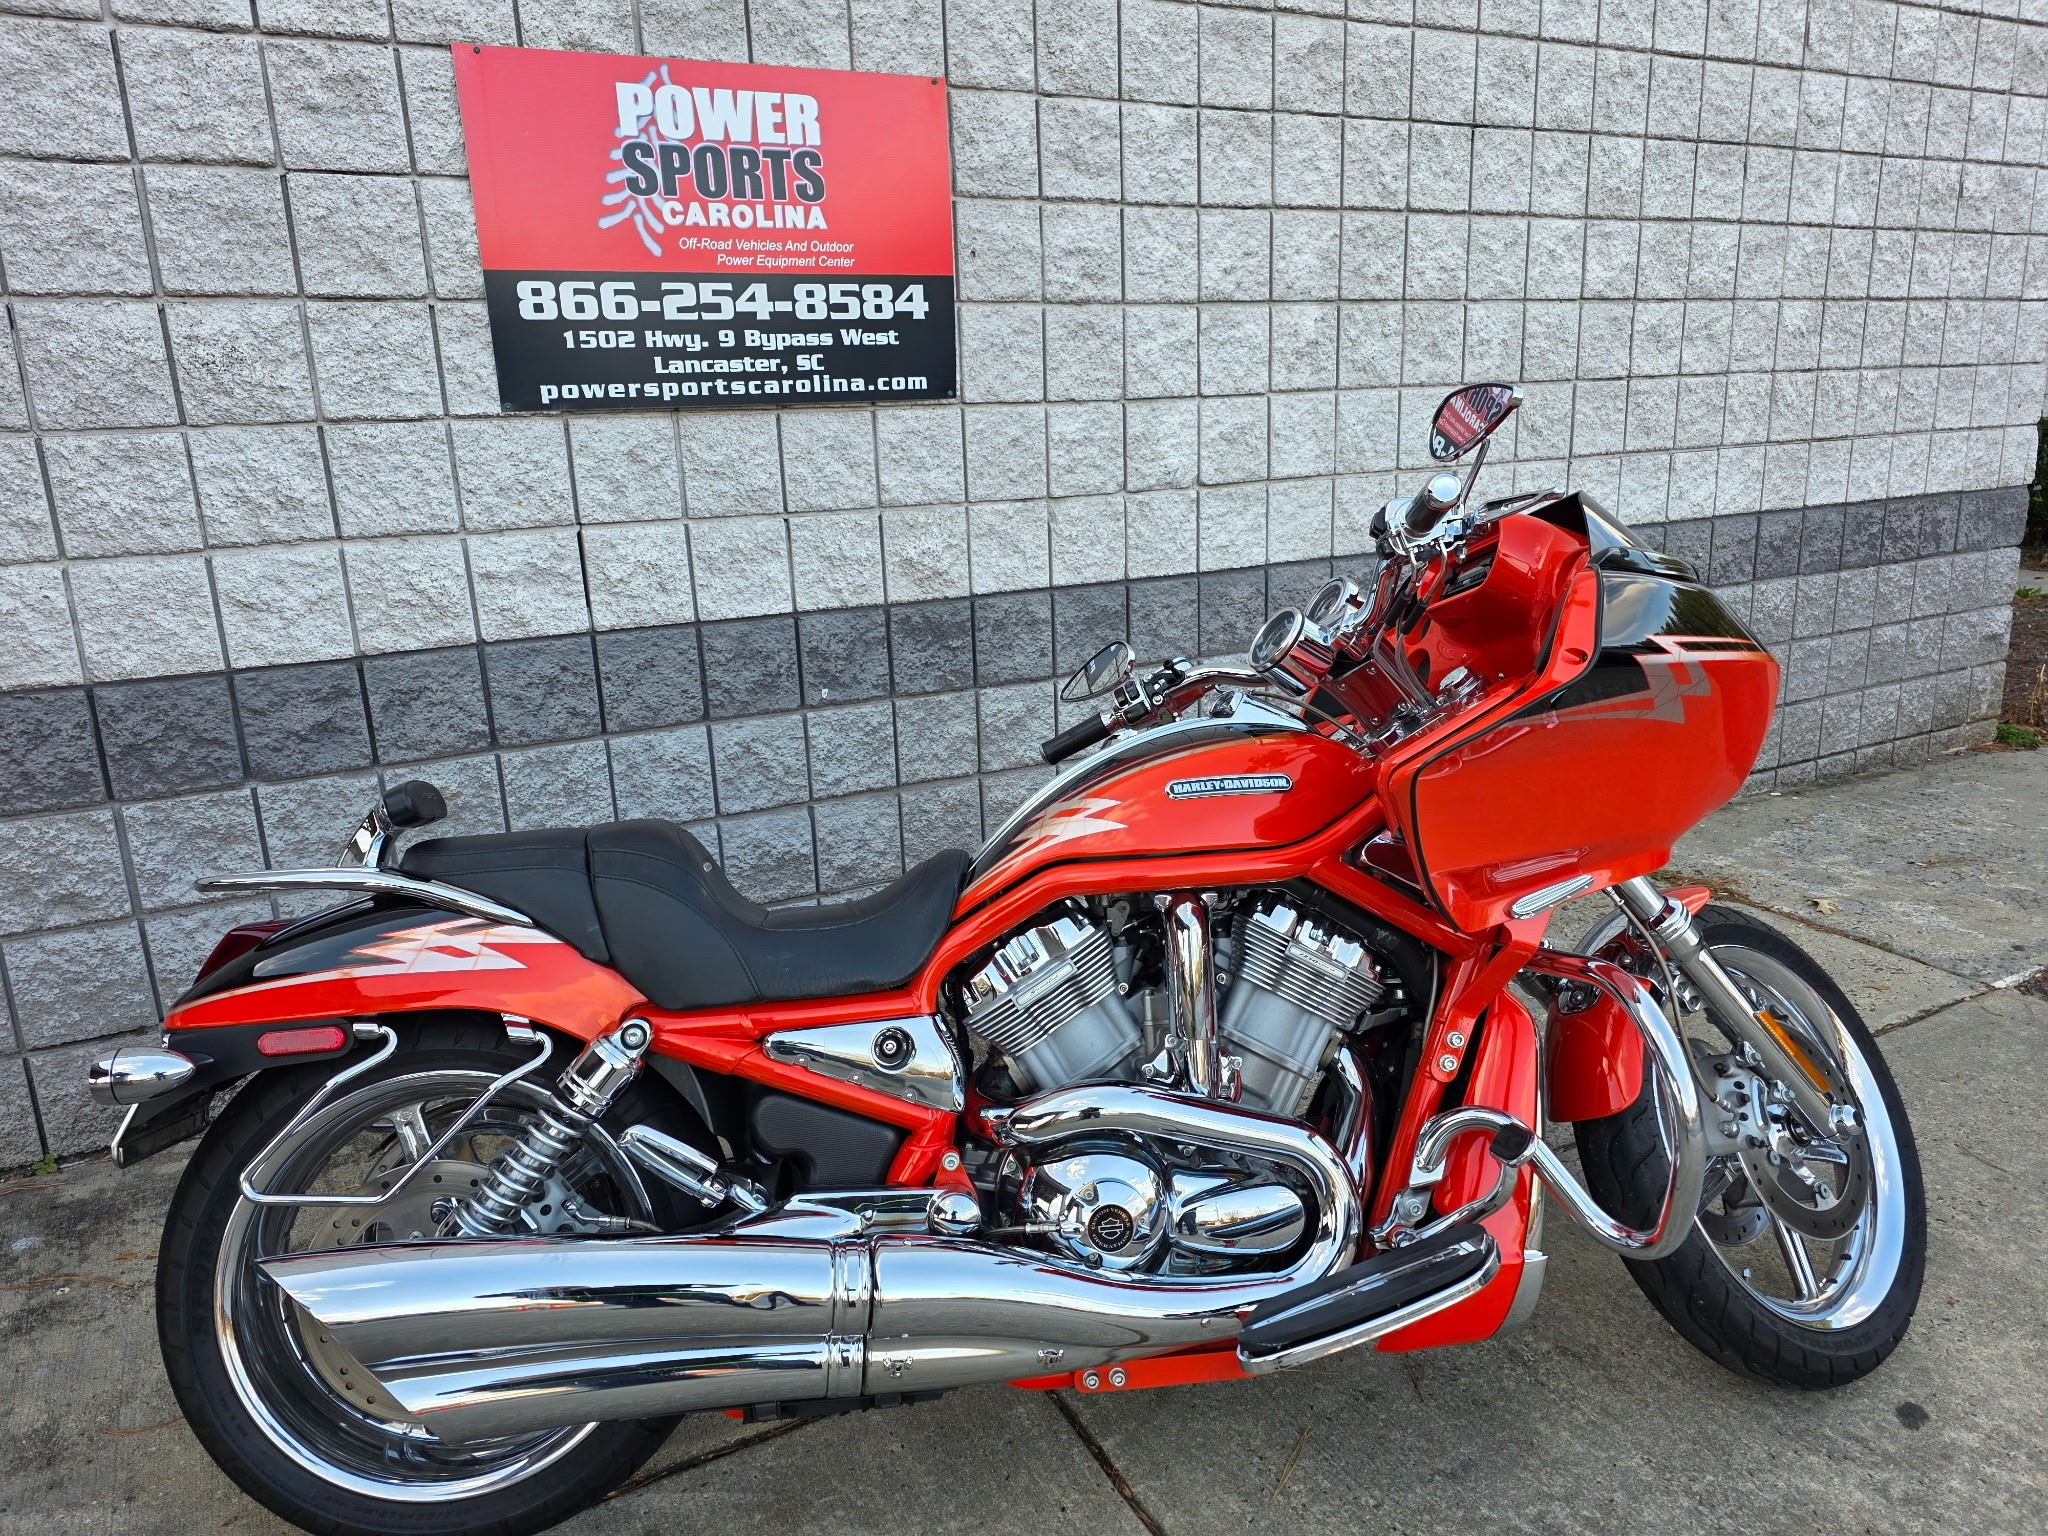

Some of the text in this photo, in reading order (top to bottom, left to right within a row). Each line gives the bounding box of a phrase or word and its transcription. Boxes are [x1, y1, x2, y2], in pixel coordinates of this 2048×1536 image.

[615, 82, 822, 146] POWER
[621, 139, 825, 203] SPORTS
[662, 200, 828, 230] CAROLINA
[679, 237, 855, 253] Off-Road Vehicles And Outdoor
[717, 253, 855, 269] Power Equipment Center
[516, 280, 930, 321] 866-254-8584
[563, 328, 900, 352] 1502 Hwy. 9 Bypass West
[654, 353, 825, 375] Lancaster, SC
[540, 374, 928, 405] powersportscarolina.com
[1091, 1207, 1110, 1230] CUSTOM
[1092, 1230, 1130, 1249] OPERATIONS
